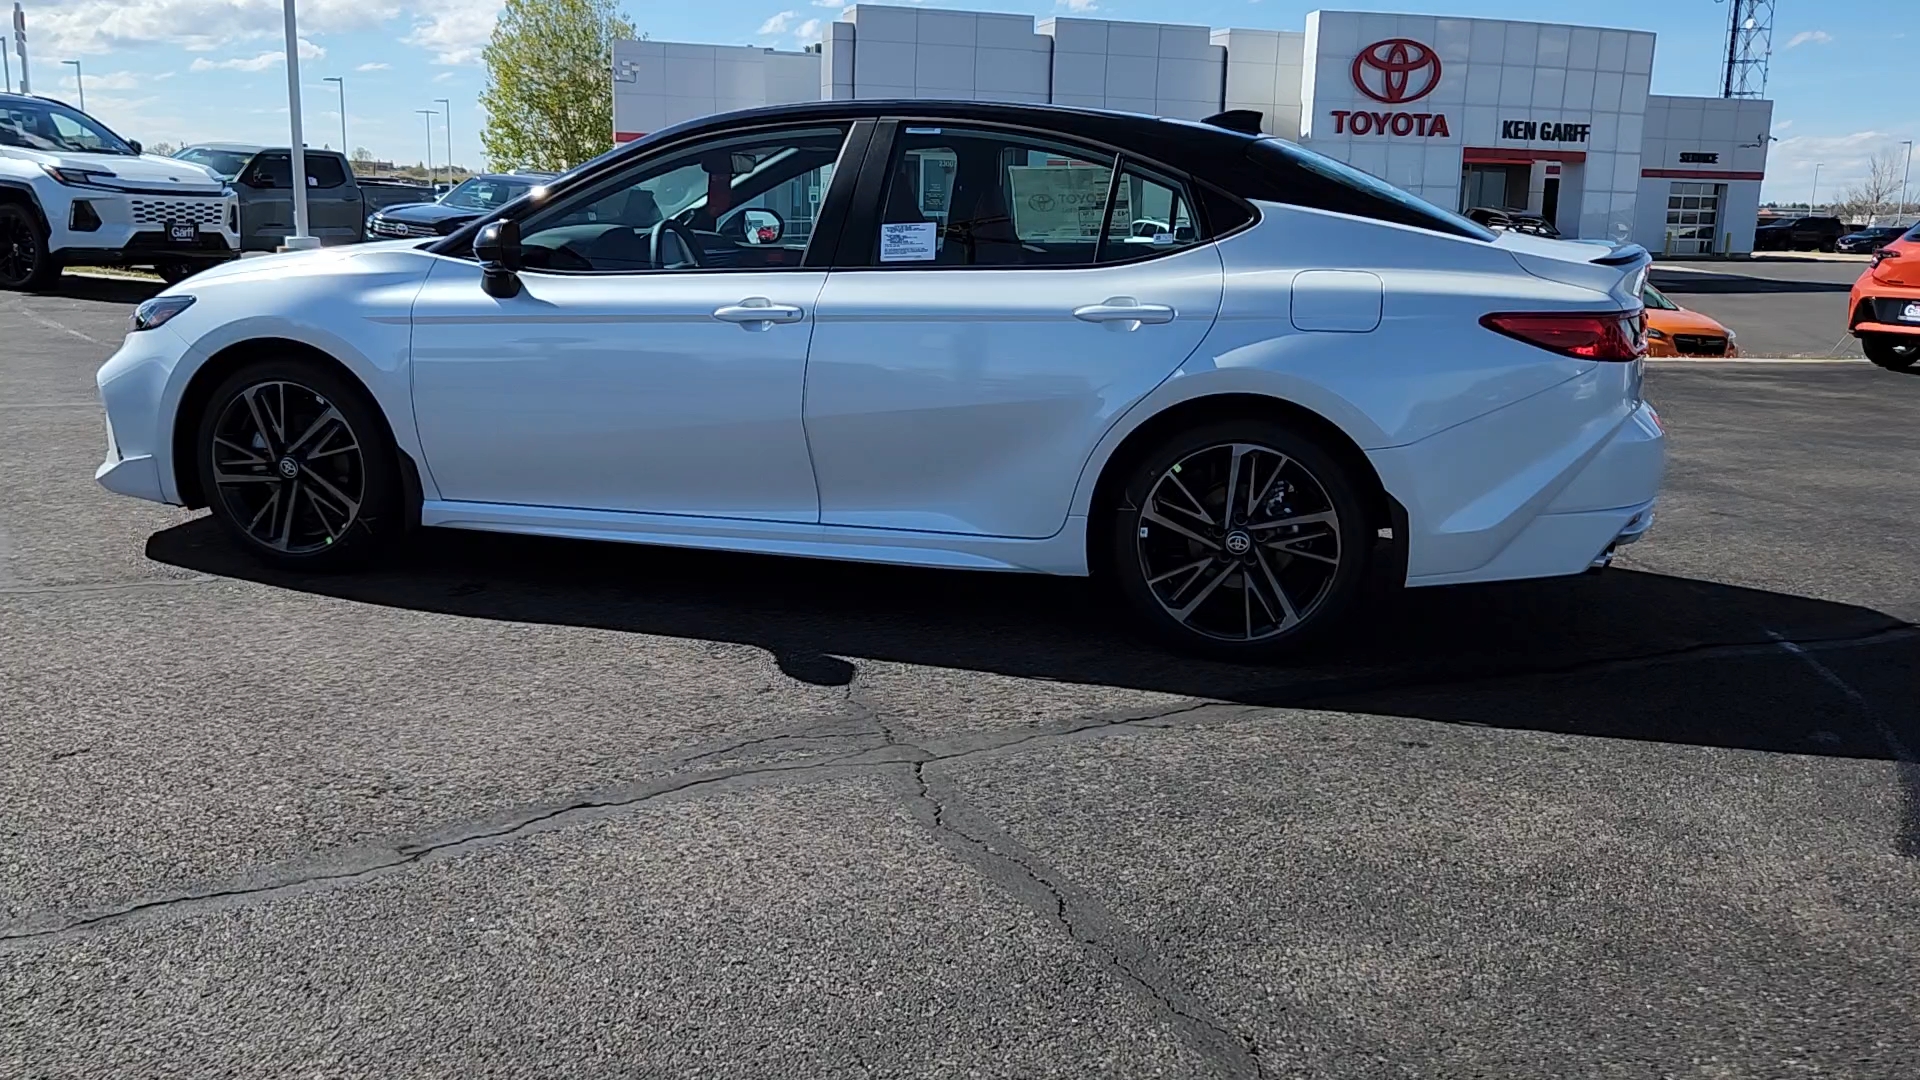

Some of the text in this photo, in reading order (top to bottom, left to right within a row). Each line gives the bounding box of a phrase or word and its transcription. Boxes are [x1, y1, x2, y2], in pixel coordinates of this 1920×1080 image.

[1331, 110, 1450, 137] TOYOTA
[1502, 120, 1591, 142] KEN GARFF
[171, 226, 194, 238] Garff
